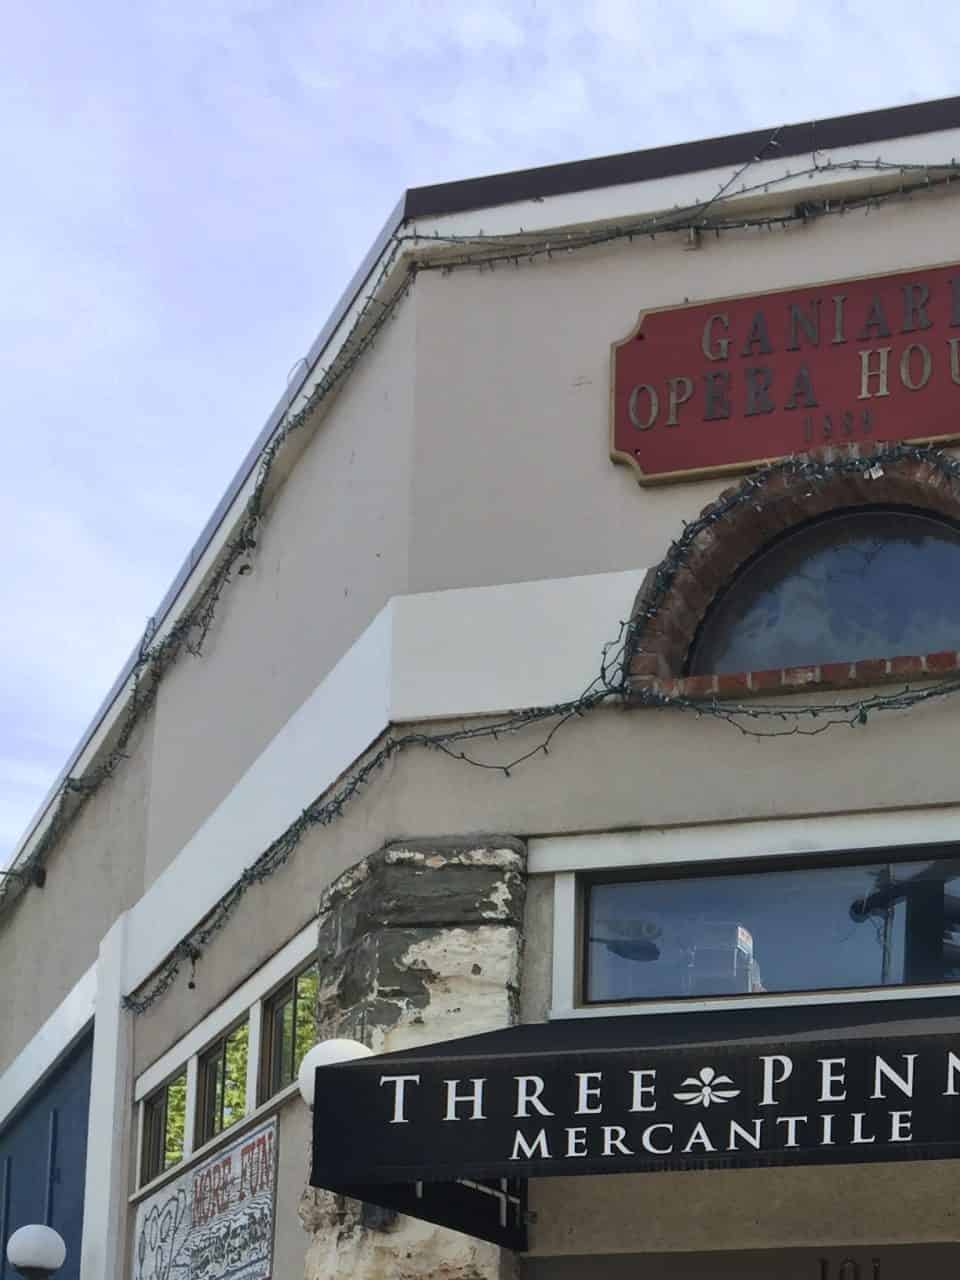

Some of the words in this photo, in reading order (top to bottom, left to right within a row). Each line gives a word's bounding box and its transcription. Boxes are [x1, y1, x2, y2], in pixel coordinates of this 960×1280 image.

[627, 366, 819, 431] OPERA
[379, 1067, 658, 1124] THREE
[508, 1109, 916, 1160] MERCANTILE
